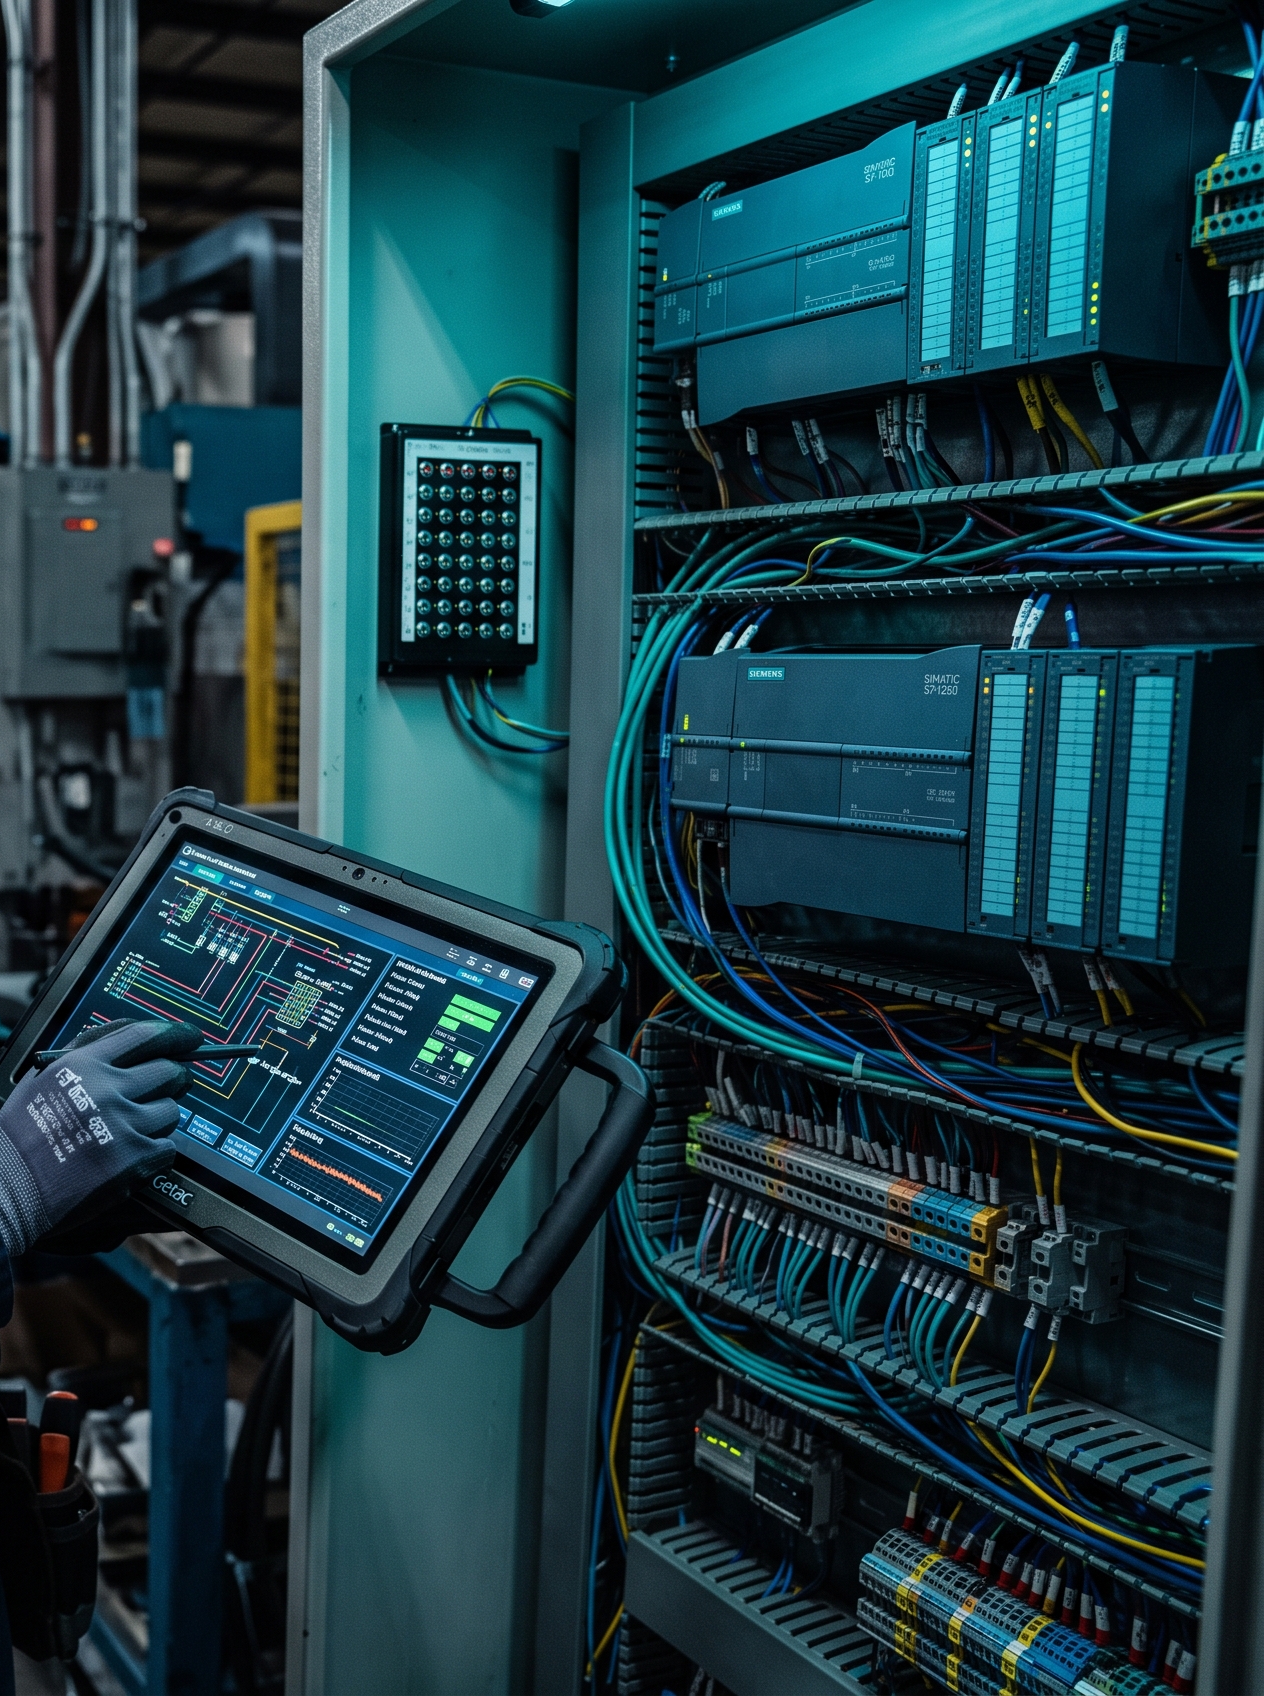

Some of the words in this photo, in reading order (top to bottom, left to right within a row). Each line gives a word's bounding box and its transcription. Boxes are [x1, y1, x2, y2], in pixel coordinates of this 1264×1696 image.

[749, 670, 783, 678] SIEMENS
[924, 674, 960, 684] SIMATIC
[152, 1175, 194, 1205] Getac
